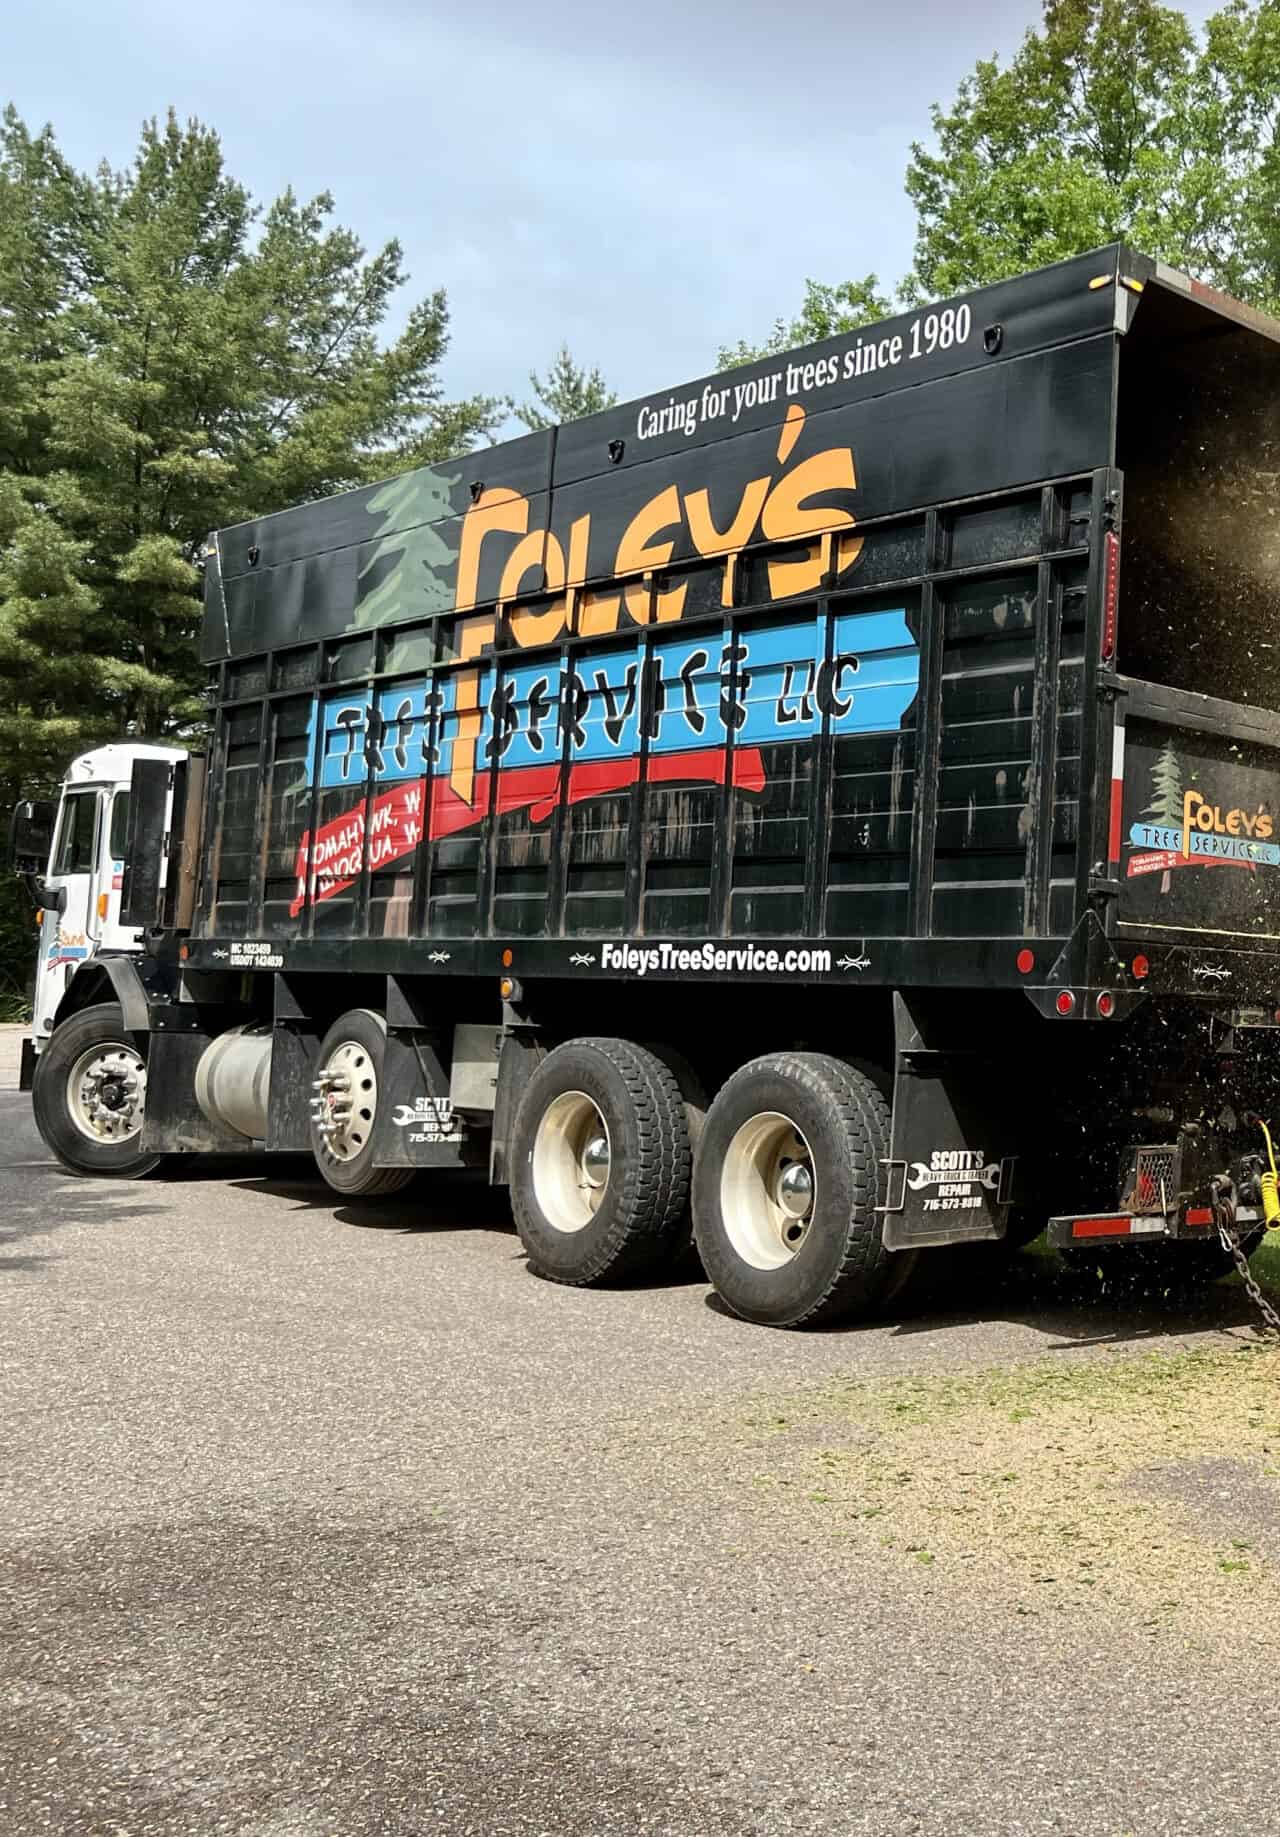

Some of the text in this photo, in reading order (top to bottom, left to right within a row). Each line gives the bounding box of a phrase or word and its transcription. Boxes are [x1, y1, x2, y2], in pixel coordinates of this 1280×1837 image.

[637, 303, 971, 440] Caring for your trees since 1980
[1142, 828, 1179, 849] TREE
[601, 943, 831, 976] FoleysTreeService.com
[930, 1150, 985, 1171] SCOTT'S
[938, 1183, 972, 1197] REPAIR
